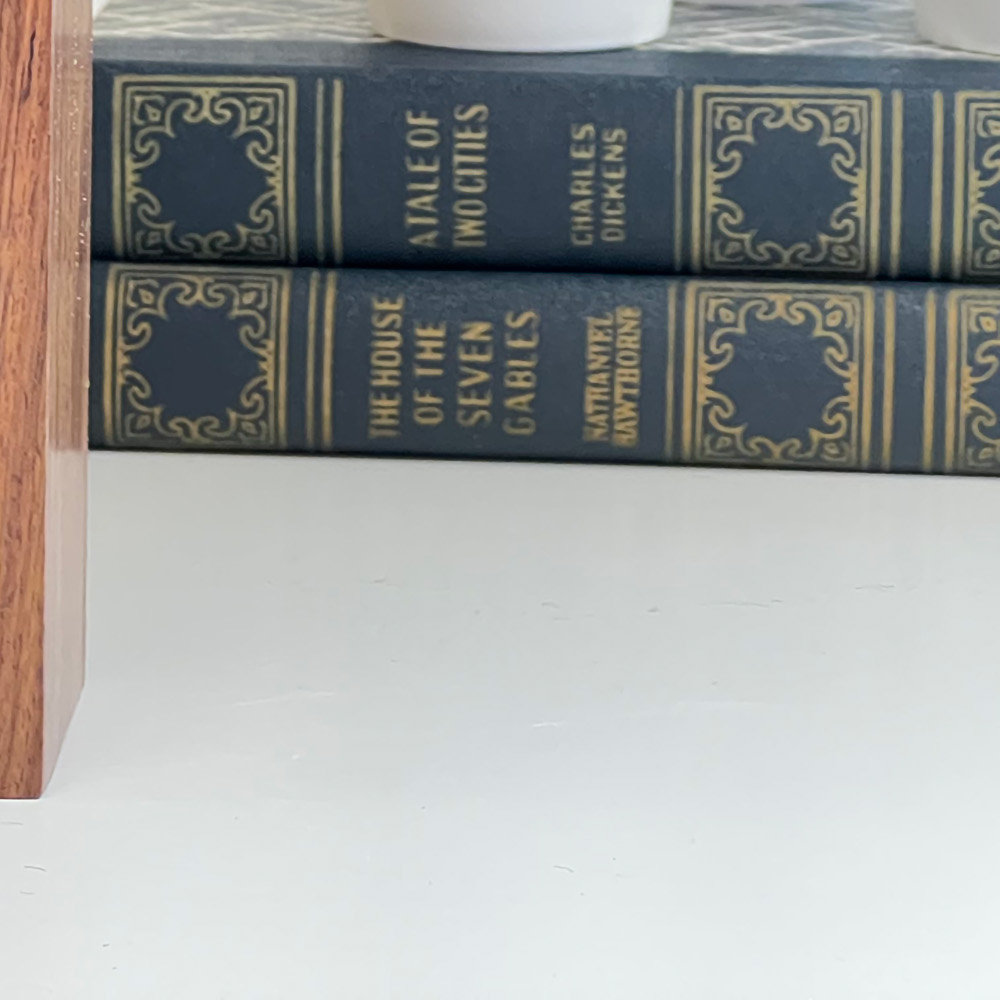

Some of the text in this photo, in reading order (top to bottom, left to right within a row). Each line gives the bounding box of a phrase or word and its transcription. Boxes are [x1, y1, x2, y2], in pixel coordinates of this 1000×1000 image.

[405, 109, 441, 248] A TALE OF
[453, 104, 490, 247] TWO CITIES
[570, 123, 596, 246] CHARLES
[601, 128, 627, 242] DICKENS
[368, 294, 405, 438] THE HOUSE
[413, 321, 447, 426] OF THE
[457, 321, 493, 427] SEVEN
[503, 310, 540, 435] GABLES
[583, 311, 614, 442] NATHANIEL
[612, 306, 642, 447] HAWTHORNE
